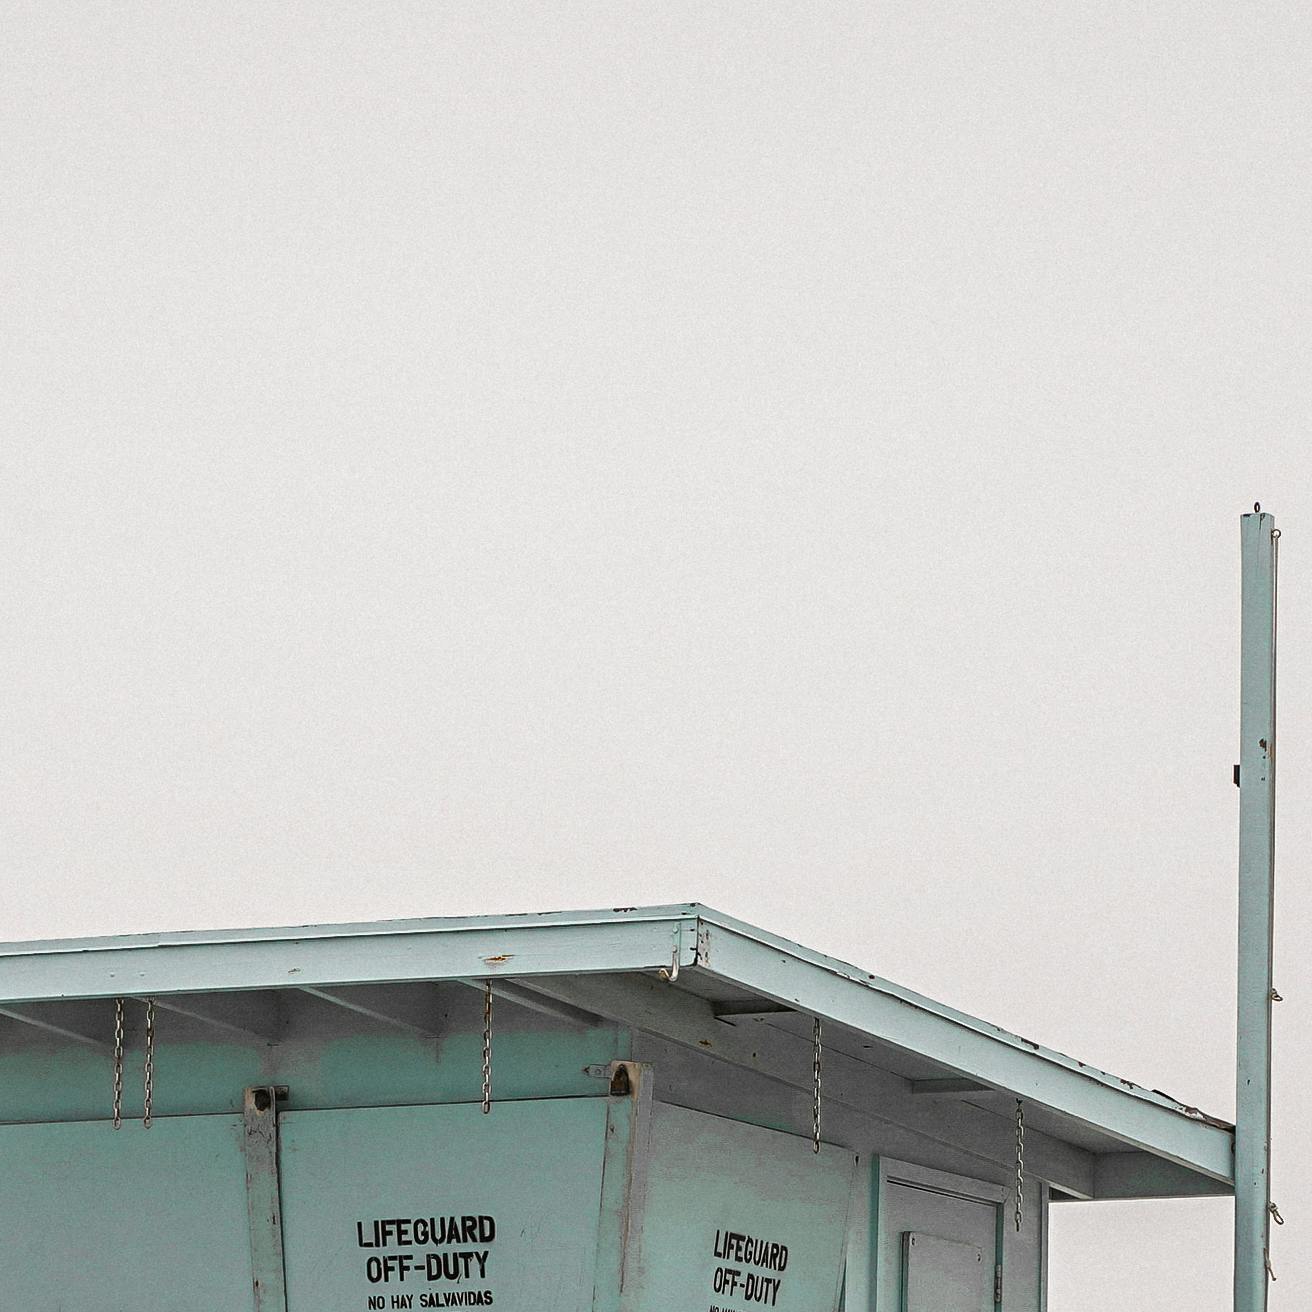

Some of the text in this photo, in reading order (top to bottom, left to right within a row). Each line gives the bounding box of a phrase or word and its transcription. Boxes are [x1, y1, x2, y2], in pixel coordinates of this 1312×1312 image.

[357, 1215, 496, 1248] LIFEGUARD
[366, 1250, 489, 1283] OFF-DUTY
[713, 1229, 788, 1272] LIFEGUARD
[368, 1290, 493, 1310] NO HAY SALVAVIDAS
[713, 1266, 781, 1307] OFF-DUTY
